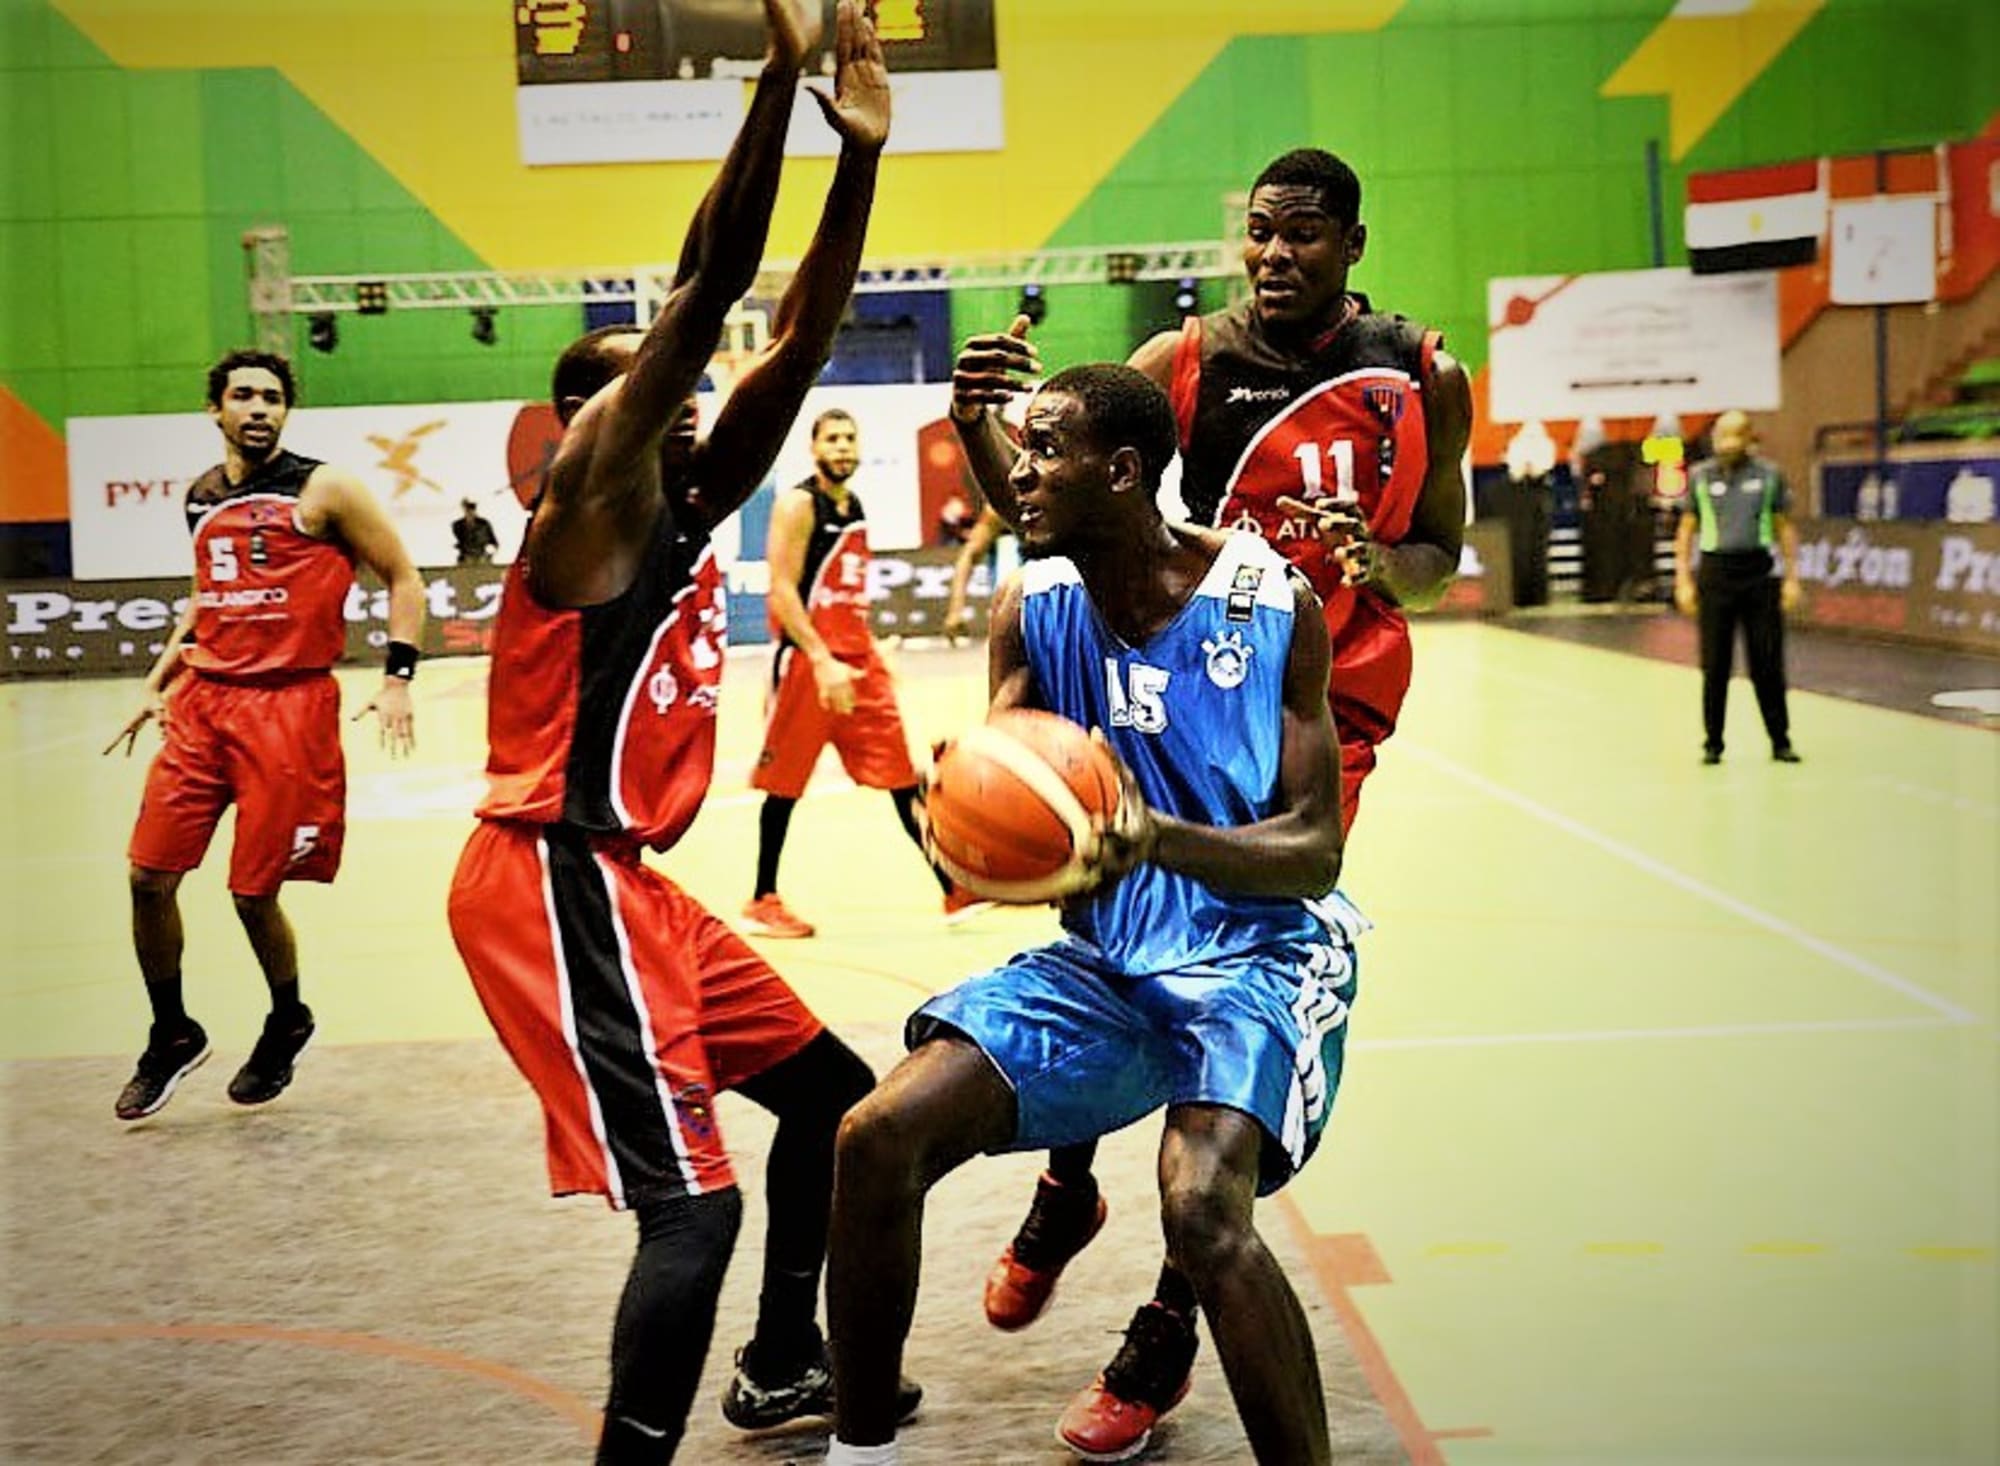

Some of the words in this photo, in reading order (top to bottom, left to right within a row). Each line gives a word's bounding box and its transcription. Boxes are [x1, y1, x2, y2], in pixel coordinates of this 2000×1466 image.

[1293, 439, 1360, 503] 11
[208, 537, 239, 581] 5
[1104, 657, 1171, 733] 15
